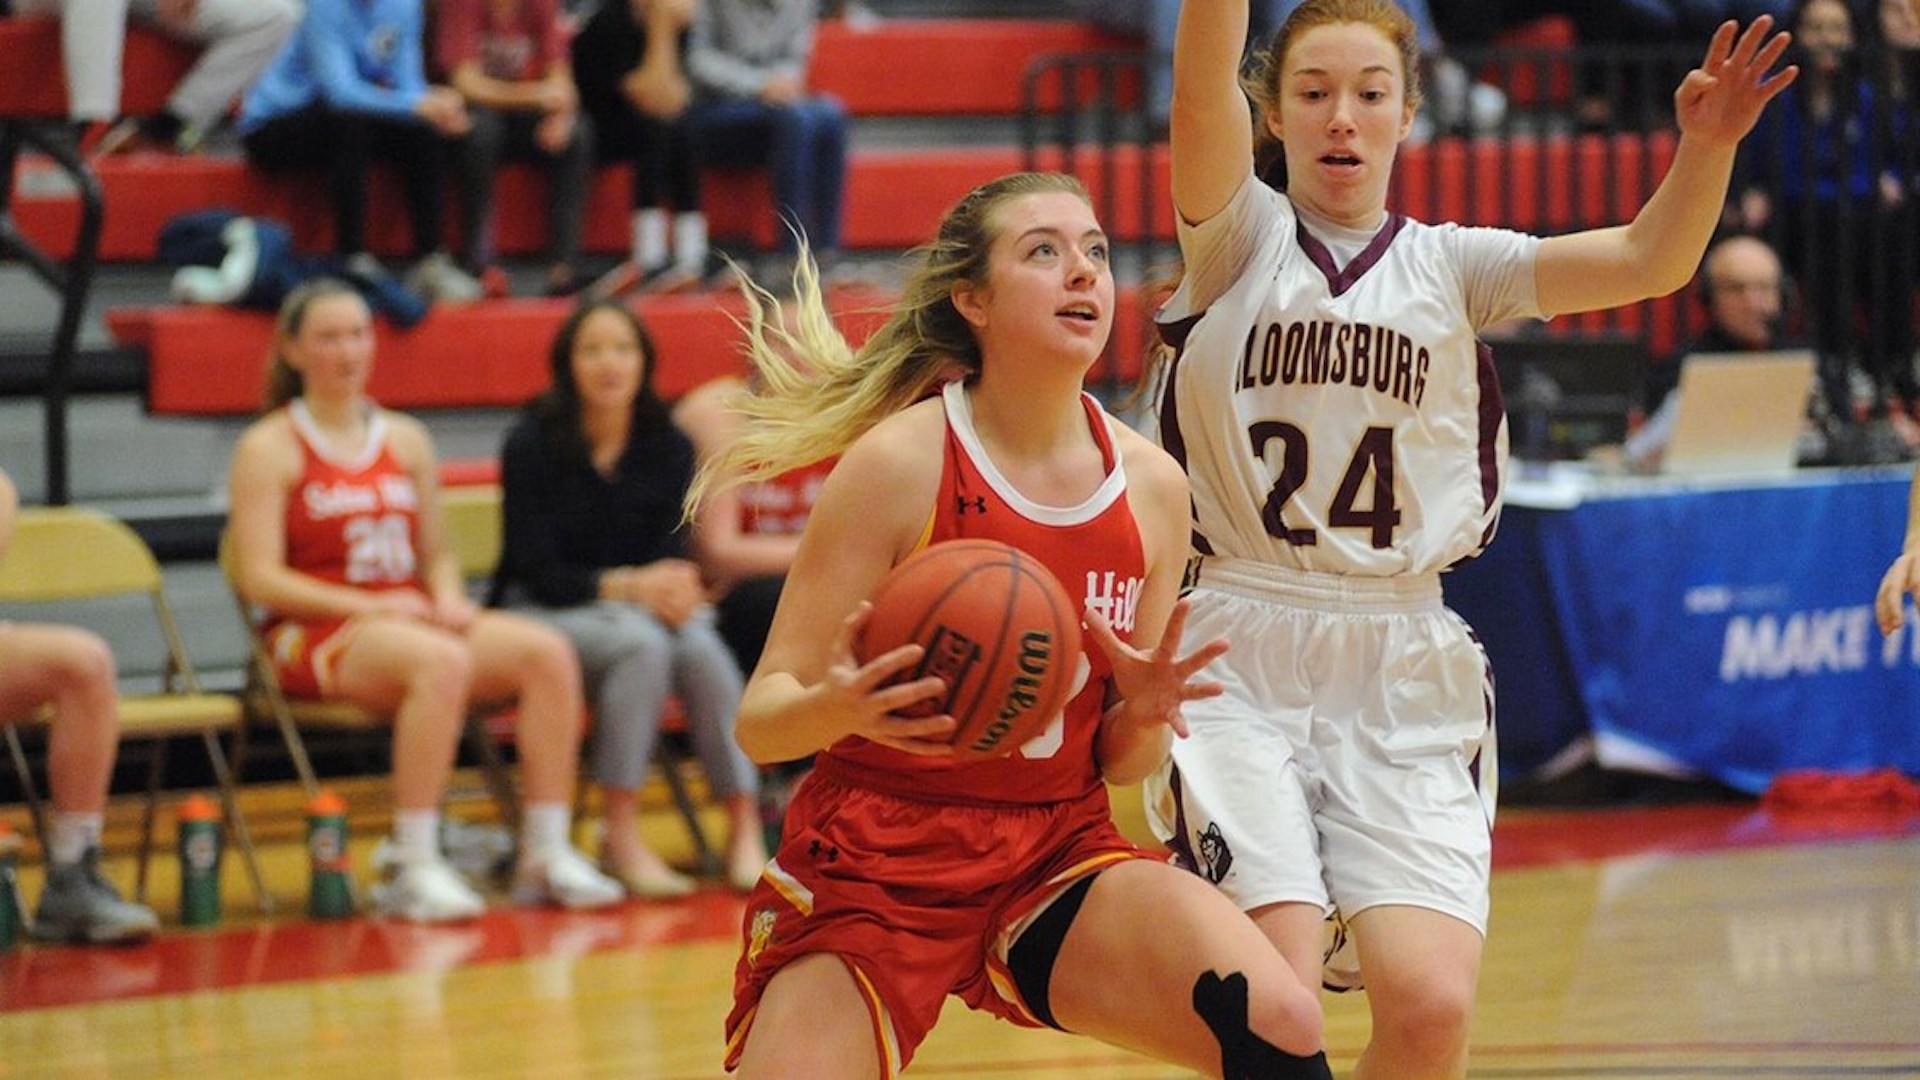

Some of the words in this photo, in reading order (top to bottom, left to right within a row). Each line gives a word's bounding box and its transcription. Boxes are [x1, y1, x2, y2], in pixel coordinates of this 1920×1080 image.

[1234, 320, 1430, 409] LOOMSBURG
[1248, 420, 1402, 549] 24
[972, 630, 1052, 752] Wilson
[1719, 603, 1872, 683] MAKE
